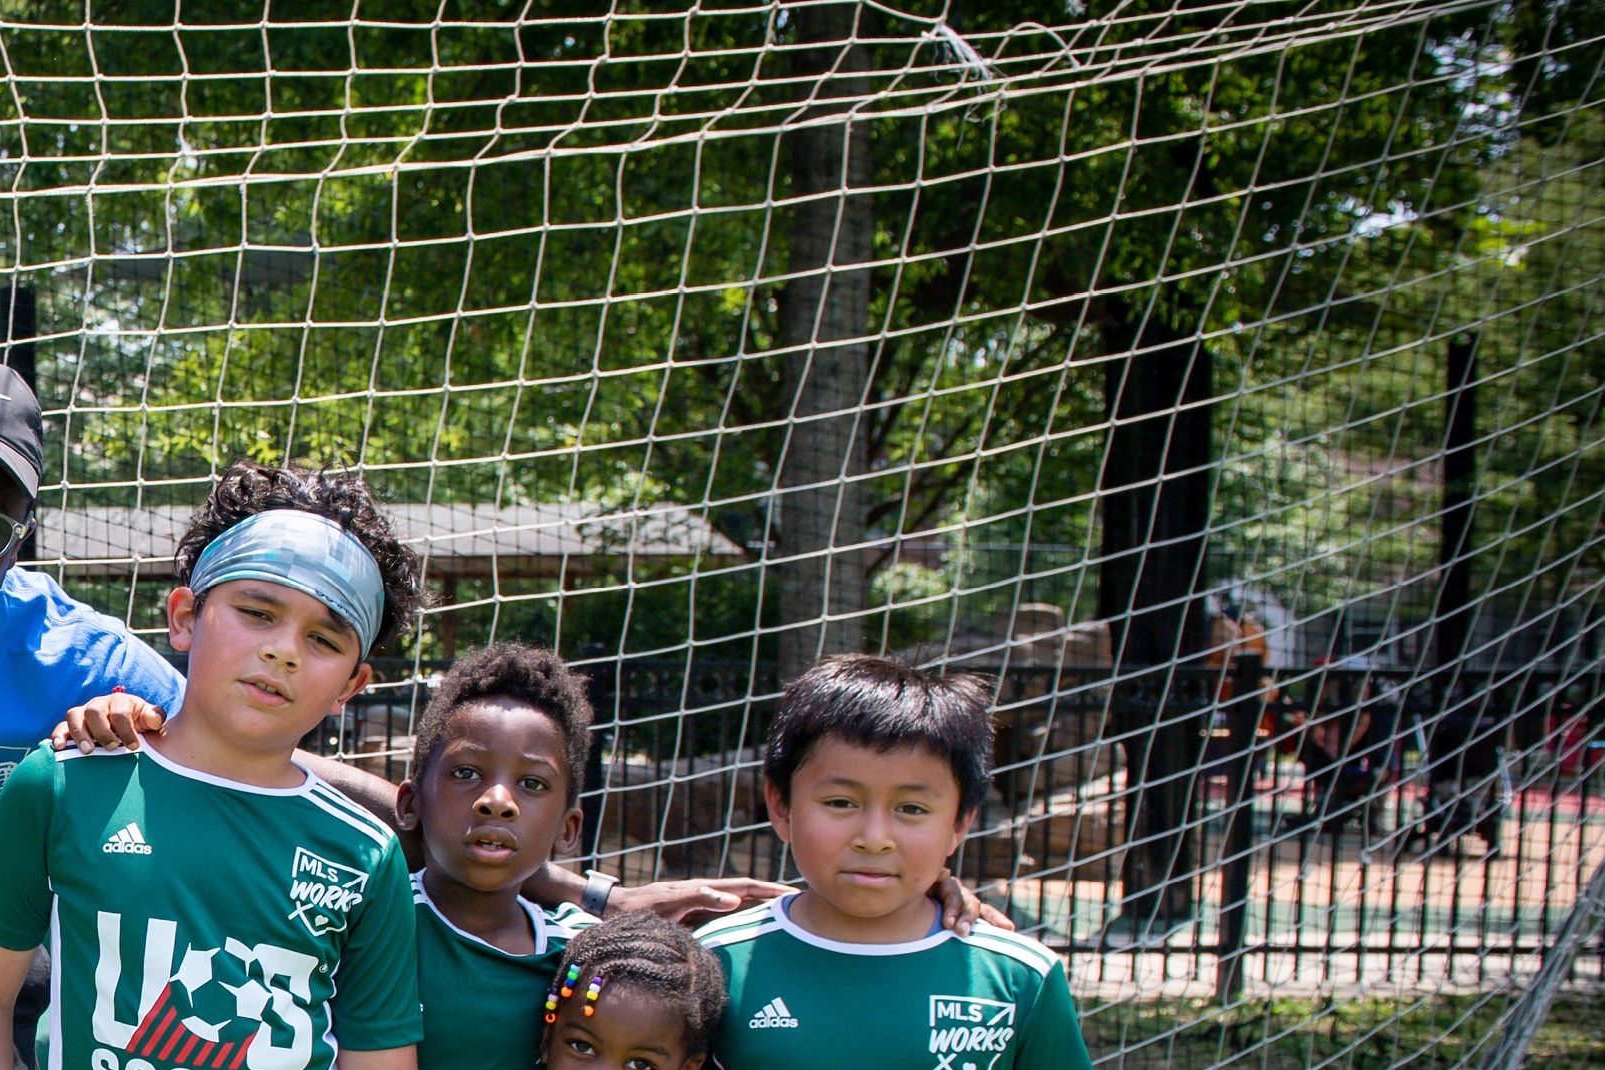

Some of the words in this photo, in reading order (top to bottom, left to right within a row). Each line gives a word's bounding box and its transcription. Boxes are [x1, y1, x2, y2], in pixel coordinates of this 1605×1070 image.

[102, 841, 152, 855] adidas
[300, 855, 338, 883] MLS
[749, 1015, 798, 1029] adidas
[936, 1001, 983, 1023] MLS
[929, 1026, 1014, 1054] WORKS
